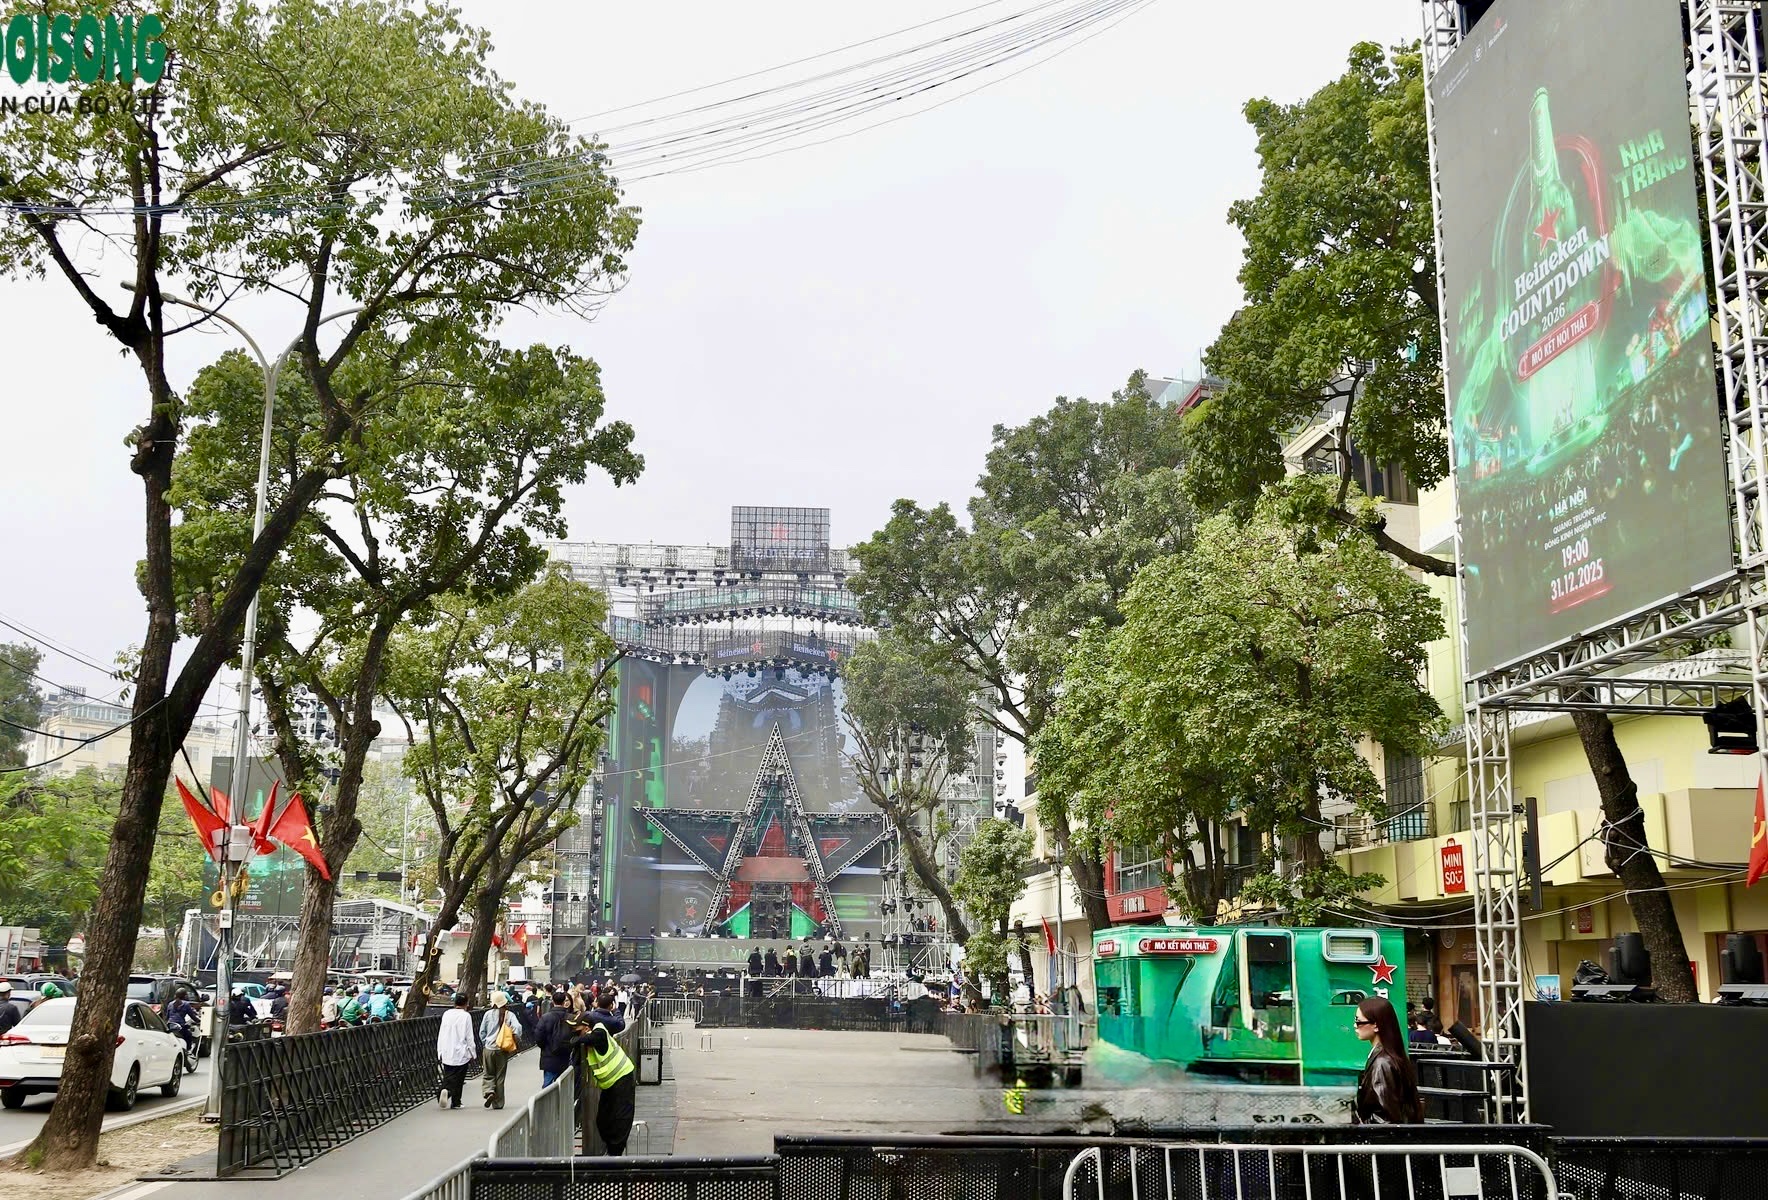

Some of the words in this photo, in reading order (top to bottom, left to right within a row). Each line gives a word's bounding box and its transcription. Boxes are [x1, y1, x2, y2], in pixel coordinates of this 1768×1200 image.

[1618, 129, 1665, 168] NHA
[1613, 154, 1687, 199] TRANG
[1514, 226, 1589, 301] Heineken
[1500, 233, 1610, 343] COUNTDOWN
[1541, 302, 1566, 332] 2026
[1561, 537, 1589, 568] 19:00
[1550, 557, 1604, 601] 31.12.2025
[717, 646, 750, 658] Heineken
[793, 643, 826, 658] Heineken
[1443, 852, 1462, 868] MINI
[1154, 939, 1166, 950] MỞ
[1167, 938, 1179, 950] KẾT
[1180, 938, 1193, 950] NỐI
